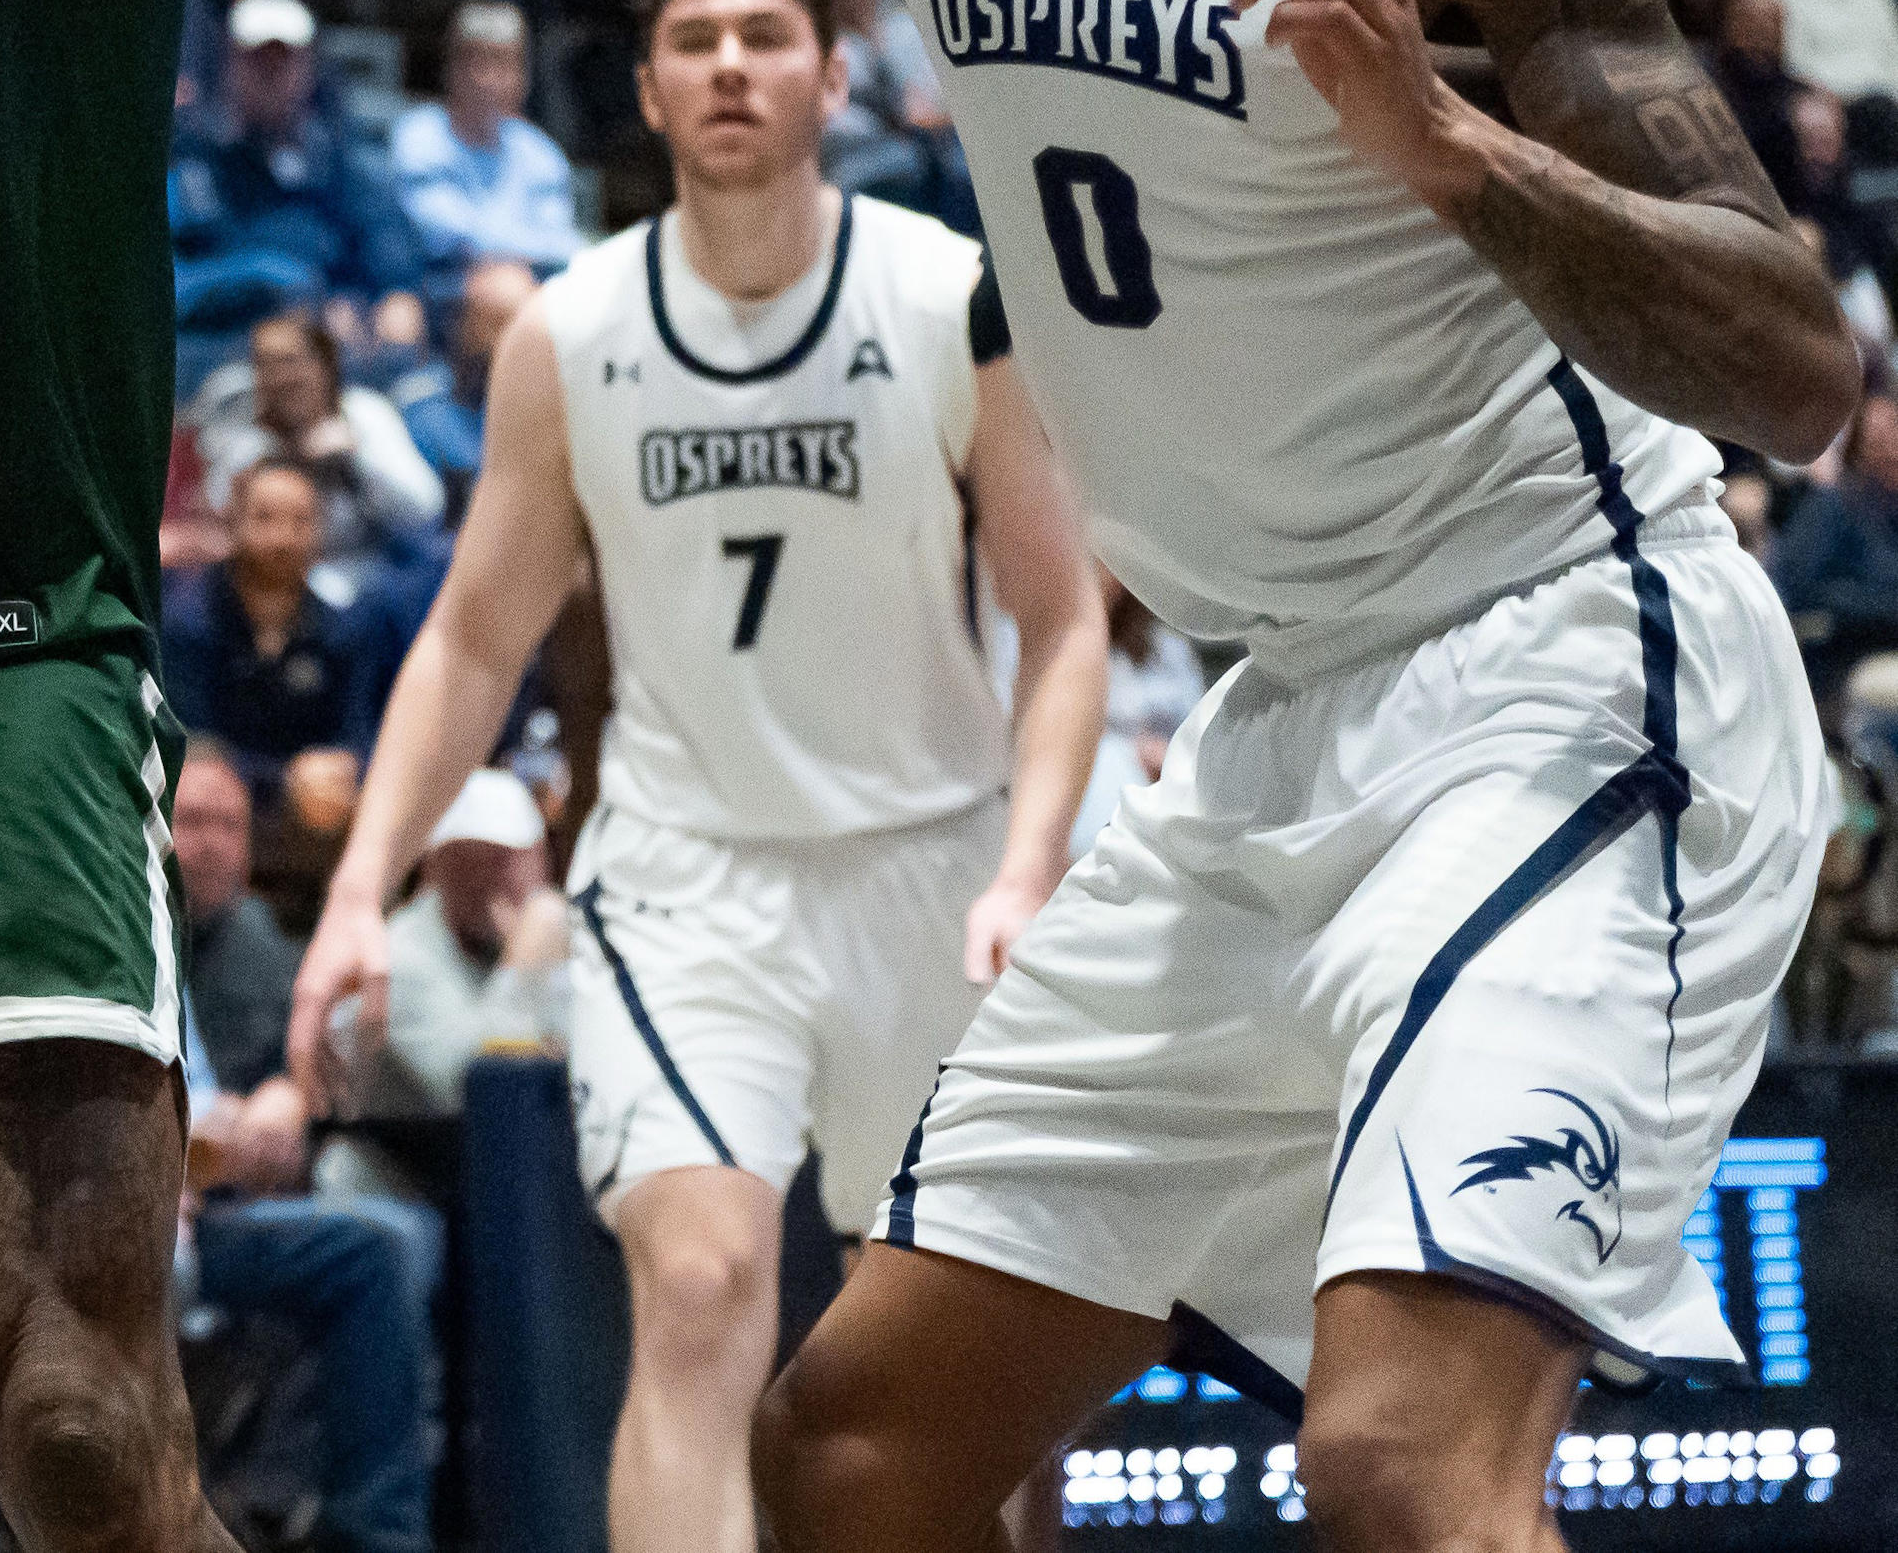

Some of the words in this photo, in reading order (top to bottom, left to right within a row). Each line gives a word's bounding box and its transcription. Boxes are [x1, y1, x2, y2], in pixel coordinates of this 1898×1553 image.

[1032, 146, 1163, 329] 0
[641, 422, 860, 506] OSPREYS
[721, 532, 786, 652] 7
